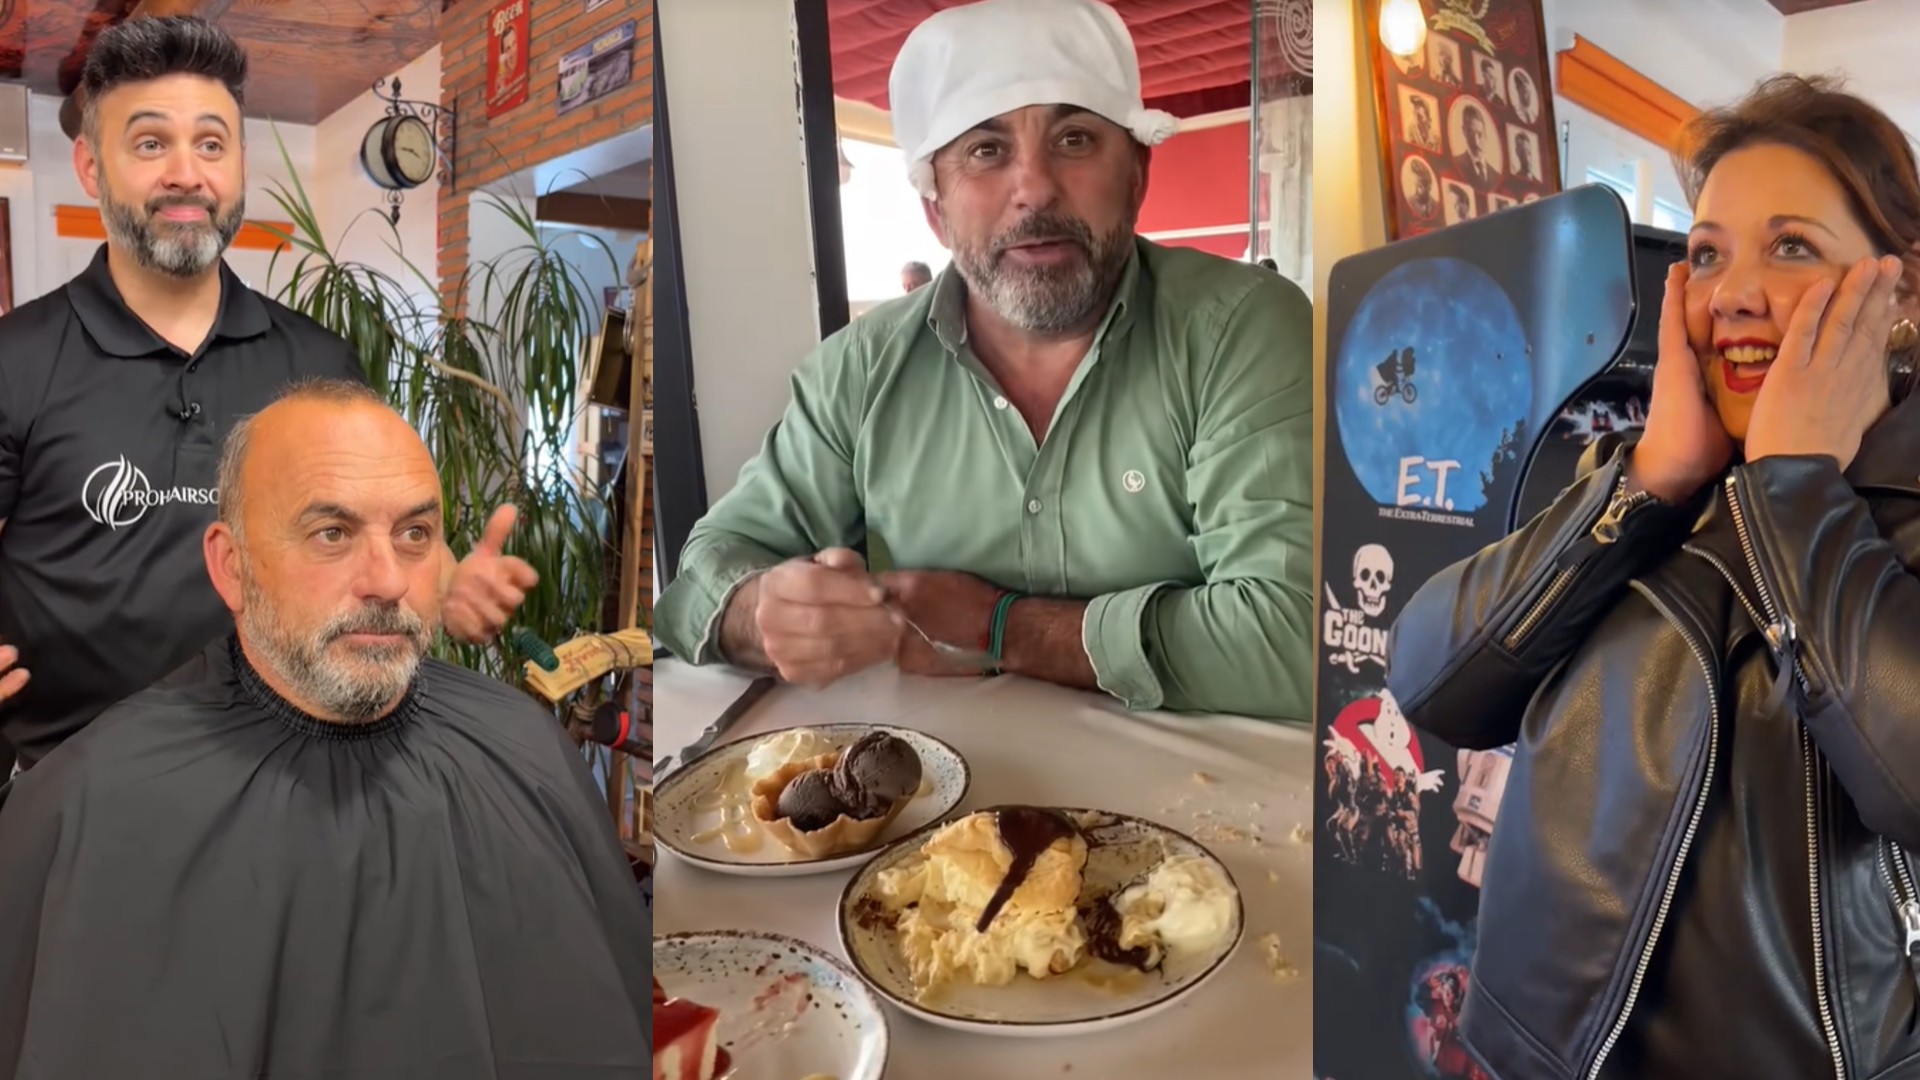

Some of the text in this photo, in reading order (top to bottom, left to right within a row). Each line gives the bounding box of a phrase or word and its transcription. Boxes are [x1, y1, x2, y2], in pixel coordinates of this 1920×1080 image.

[493, 0, 524, 37] BEER
[1397, 456, 1461, 511] E.T.
[1378, 507, 1394, 518] THE
